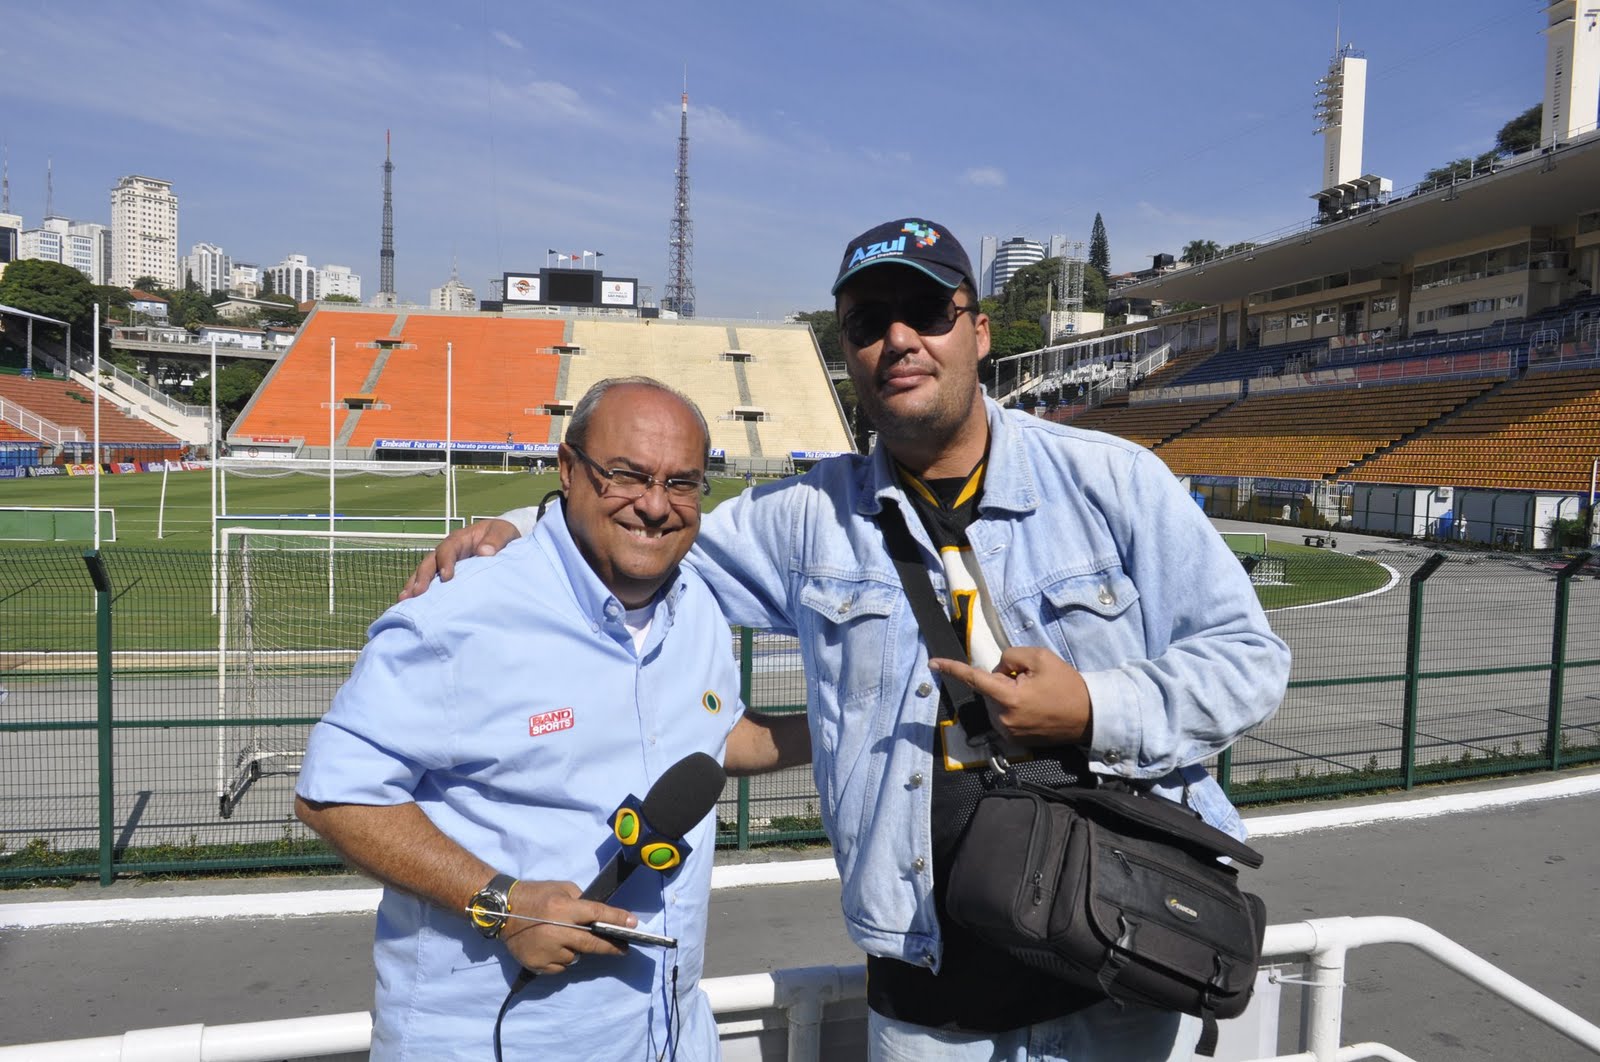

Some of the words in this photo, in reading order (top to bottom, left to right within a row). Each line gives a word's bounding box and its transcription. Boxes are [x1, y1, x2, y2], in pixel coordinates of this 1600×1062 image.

[848, 236, 906, 268] Azul
[382, 440, 411, 449] Embratel
[532, 710, 571, 726] BAND
[532, 719, 571, 735] SPORTS
